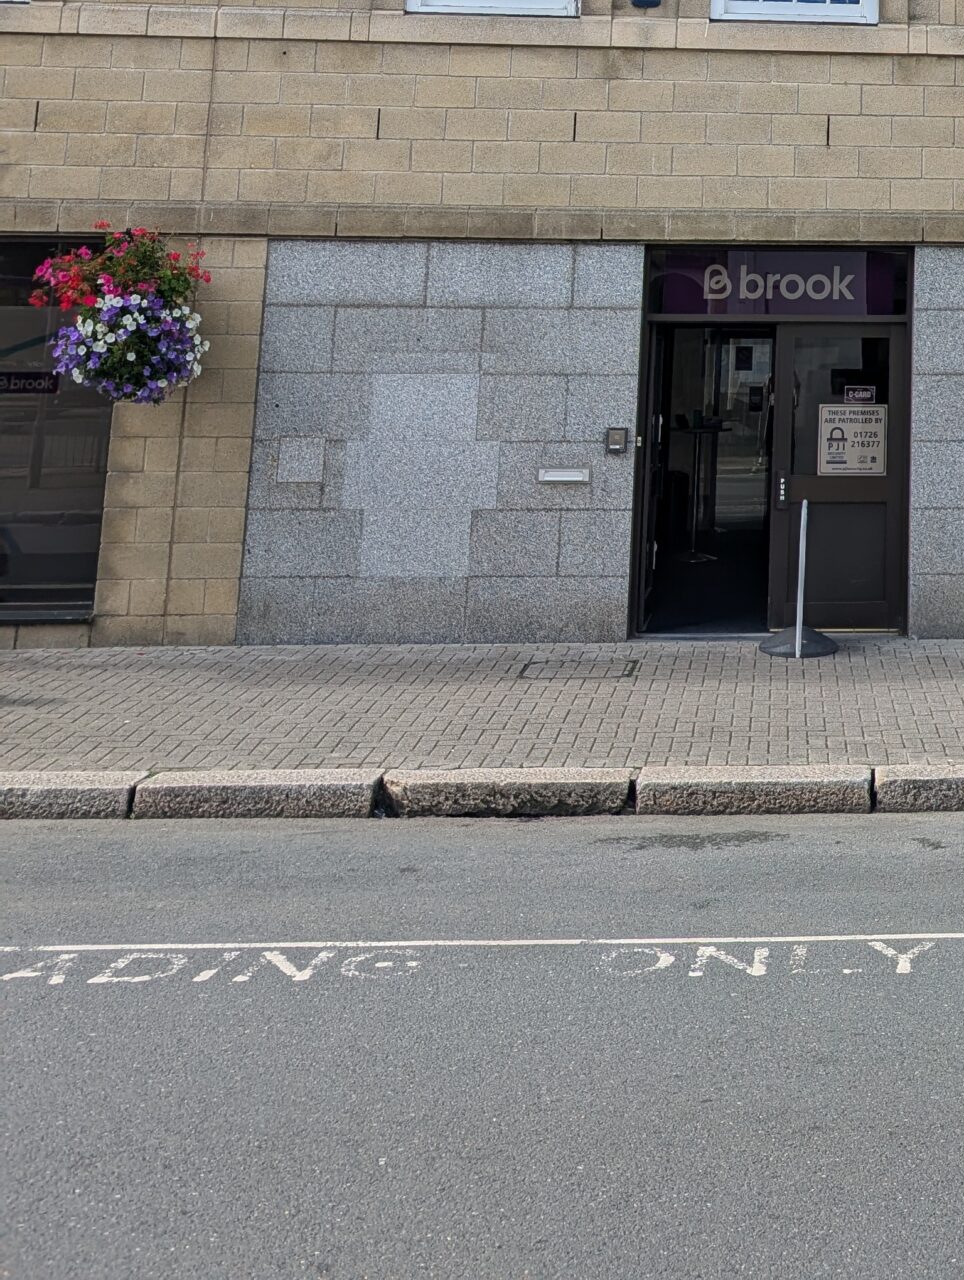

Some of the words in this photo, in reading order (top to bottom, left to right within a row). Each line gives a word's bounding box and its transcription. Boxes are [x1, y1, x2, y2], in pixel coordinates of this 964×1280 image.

[739, 264, 855, 300] brook
[10, 375, 53, 389] brook
[853, 431, 878, 439] 01726
[850, 440, 880, 448] 216377
[597, 940, 935, 978] ONLY
